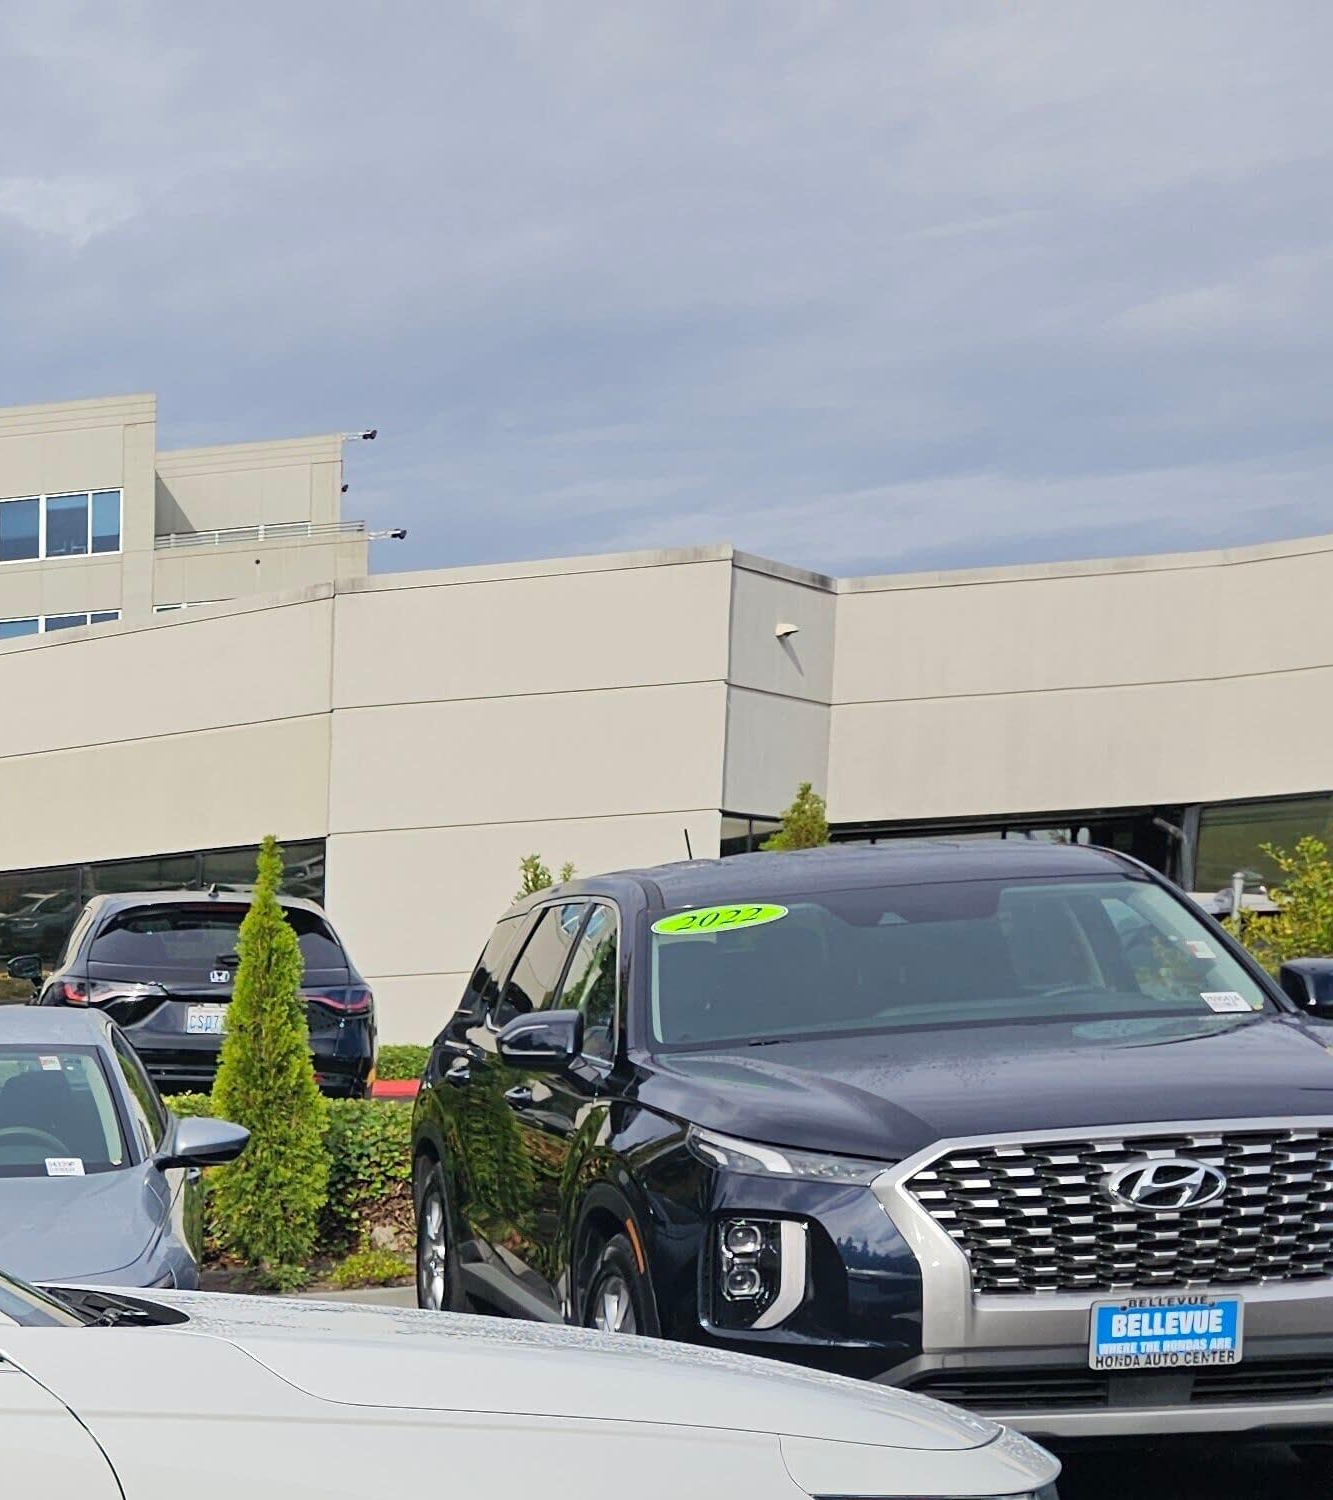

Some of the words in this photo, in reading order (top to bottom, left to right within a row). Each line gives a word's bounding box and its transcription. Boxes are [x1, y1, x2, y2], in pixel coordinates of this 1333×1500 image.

[675, 907, 762, 931] 2022
[1129, 1295, 1208, 1308] BELLEVUE
[1111, 1309, 1224, 1337] BELLEVUE
[1098, 1342, 1138, 1355] WHERE
[1140, 1340, 1160, 1353] THE
[1209, 1337, 1233, 1350] ARE
[1096, 1354, 1140, 1368] HONDA
[1145, 1353, 1179, 1367] AUTO
[1184, 1351, 1235, 1364] CENTER
